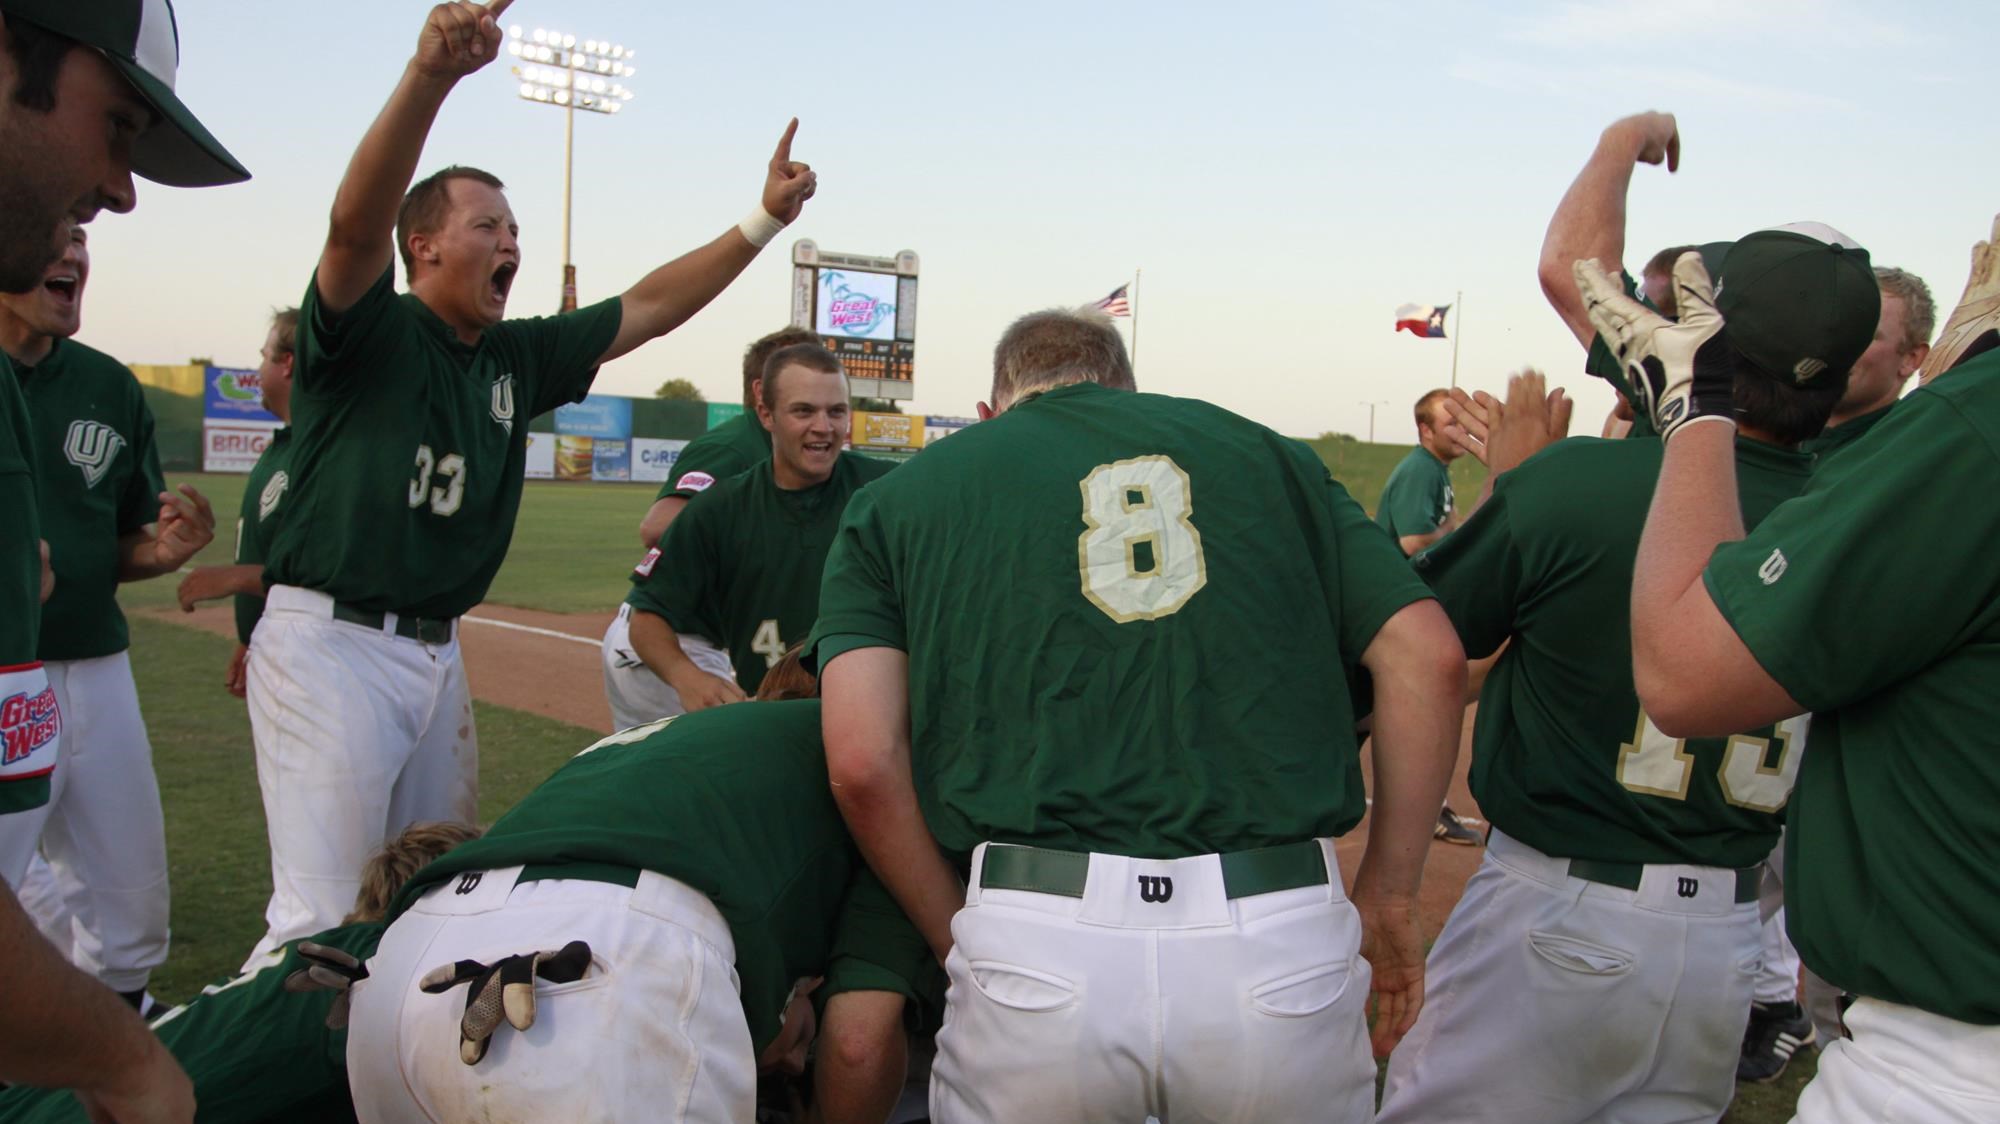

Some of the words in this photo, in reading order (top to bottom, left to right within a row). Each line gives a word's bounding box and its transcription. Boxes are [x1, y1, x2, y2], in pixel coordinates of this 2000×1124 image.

[831, 298, 877, 313] Great
[831, 312, 873, 326] West
[212, 434, 271, 453] BRIG
[409, 444, 466, 516] 33
[1078, 454, 1208, 624] 8
[752, 619, 787, 669] 4
[3, 710, 57, 764] West
